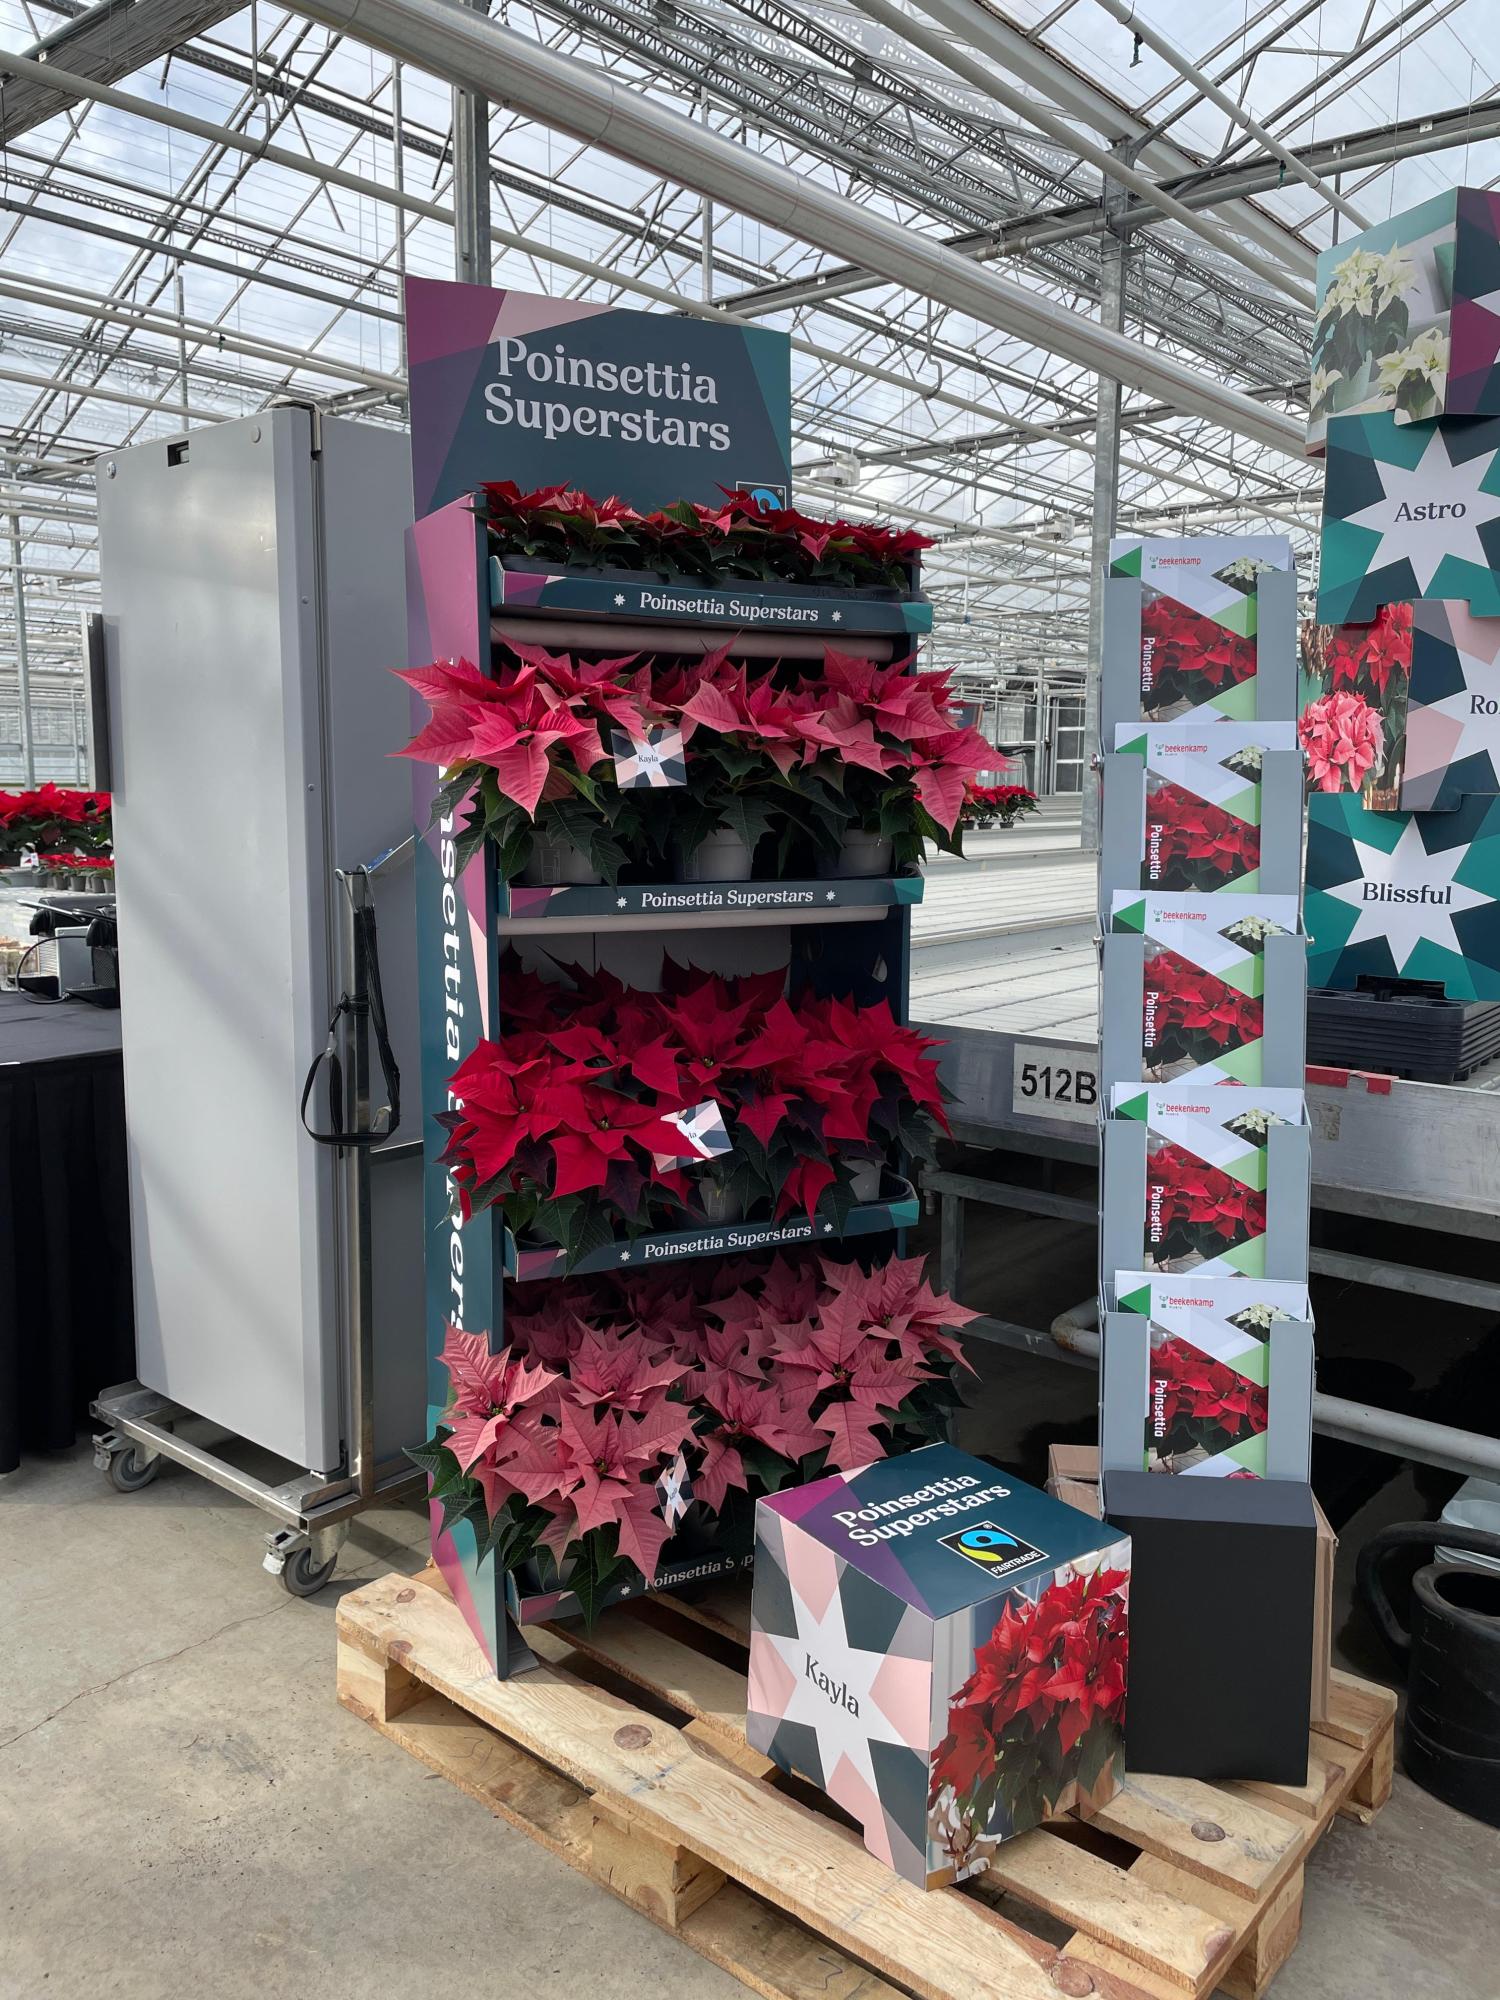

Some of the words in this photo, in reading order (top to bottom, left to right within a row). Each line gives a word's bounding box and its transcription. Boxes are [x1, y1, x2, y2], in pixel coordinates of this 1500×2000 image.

[497, 336, 718, 405] Poinsettia
[484, 382, 731, 451] Superstars
[1393, 501, 1467, 523] Astro
[1158, 556, 1201, 566] beekenkamp
[639, 591, 725, 615] Poinsettia
[729, 600, 819, 622] Superstars
[1141, 637, 1155, 692] Poinsettia
[1469, 694, 1500, 715] Ro
[638, 754, 659, 763] Kayla
[1164, 743, 1208, 753] beekenkamp
[1149, 824, 1163, 880] Poinsettia
[641, 891, 723, 908] Poinsettia
[727, 889, 814, 905] Superstars
[1362, 882, 1452, 905] Blissful
[1163, 911, 1207, 921] beekenkamp
[1145, 991, 1159, 1048] Poinsettia
[1020, 1063, 1098, 1105] 512B
[1166, 1103, 1211, 1114] beekenkamp
[1150, 1184, 1165, 1243] Poinsettia
[644, 1235, 724, 1259] Poinsettia
[727, 1225, 812, 1247] Superstars
[1168, 1296, 1214, 1308] beekenkamp
[1154, 1379, 1168, 1438] Poinsettia
[832, 1474, 982, 1529] Poinsettia
[848, 1485, 1012, 1547] Superstars
[990, 1550, 1042, 1575] FAIRTRADE
[804, 1651, 861, 1719] Kayla
